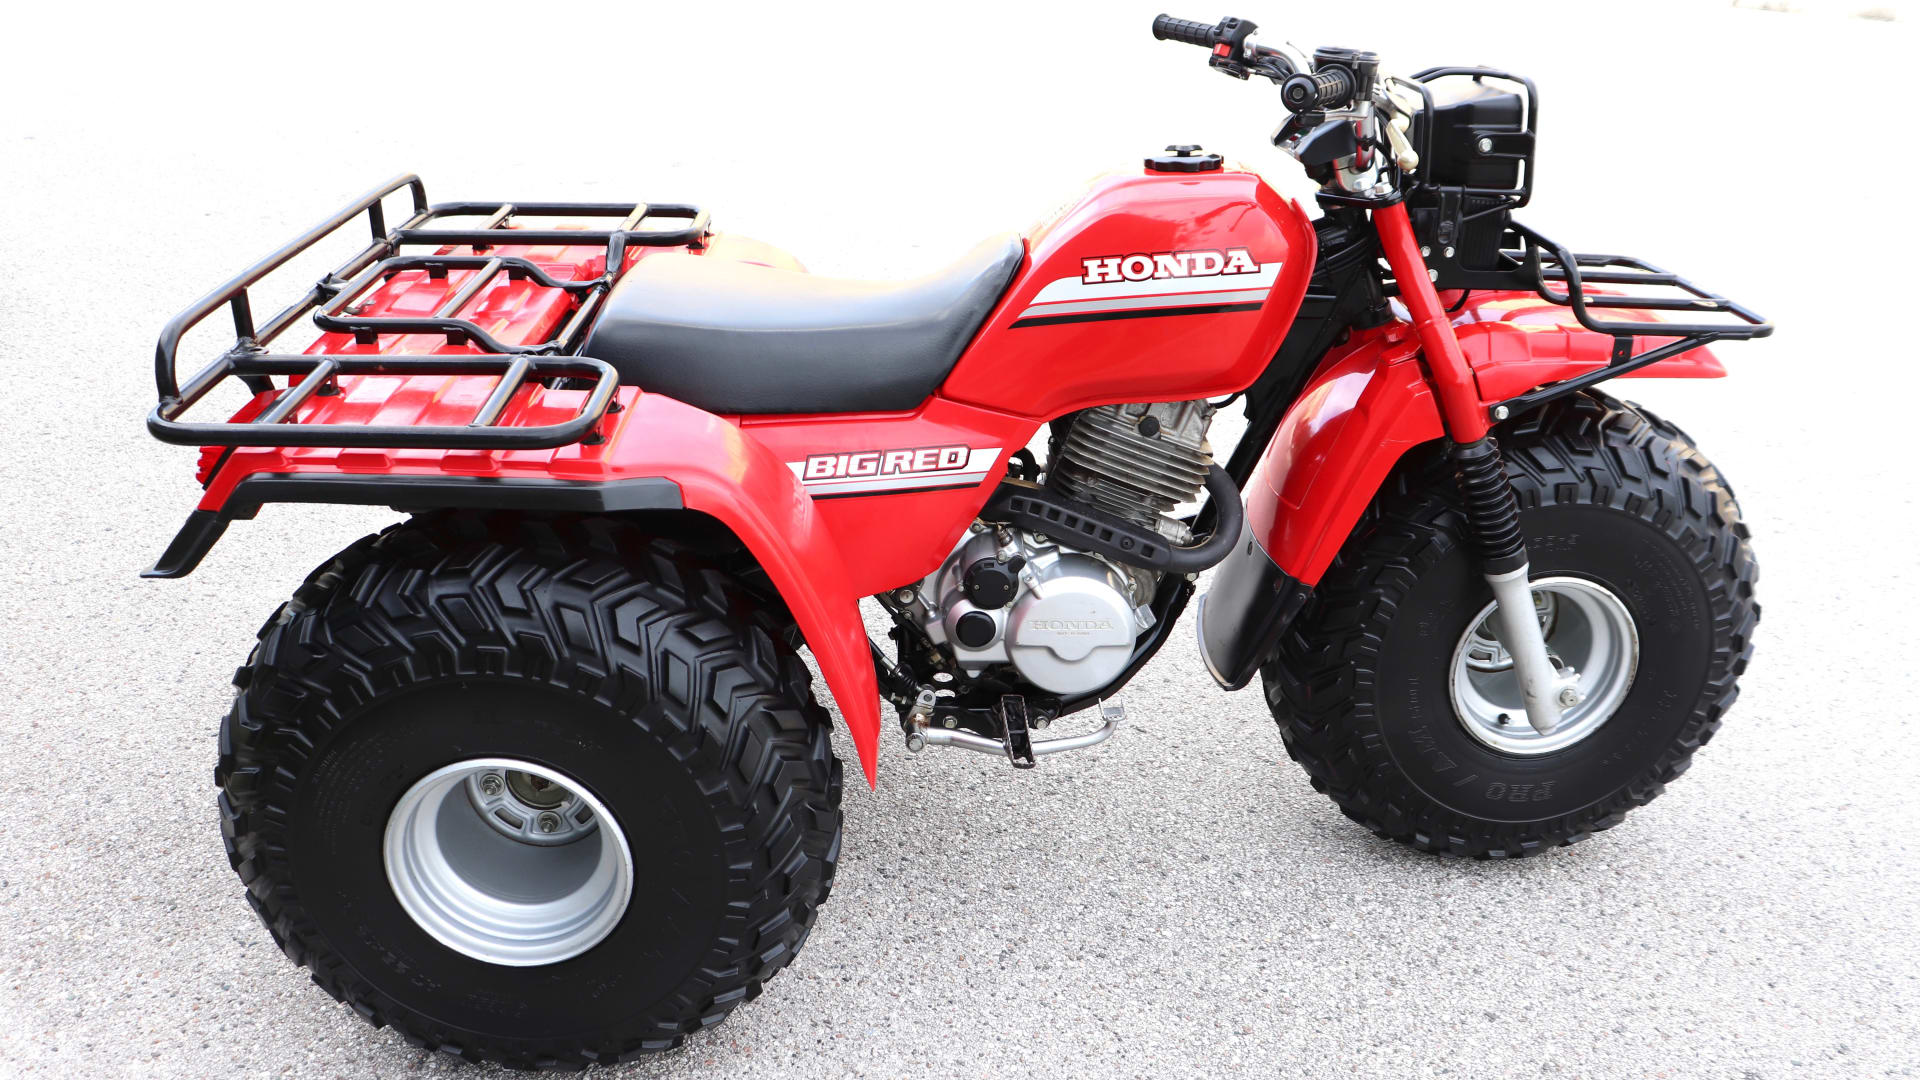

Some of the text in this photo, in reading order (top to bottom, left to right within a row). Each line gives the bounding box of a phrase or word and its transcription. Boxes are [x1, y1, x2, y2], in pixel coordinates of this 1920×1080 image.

[1081, 248, 1260, 284] HONDA
[802, 445, 971, 480] BIG RED
[1032, 620, 1114, 630] HONDA
